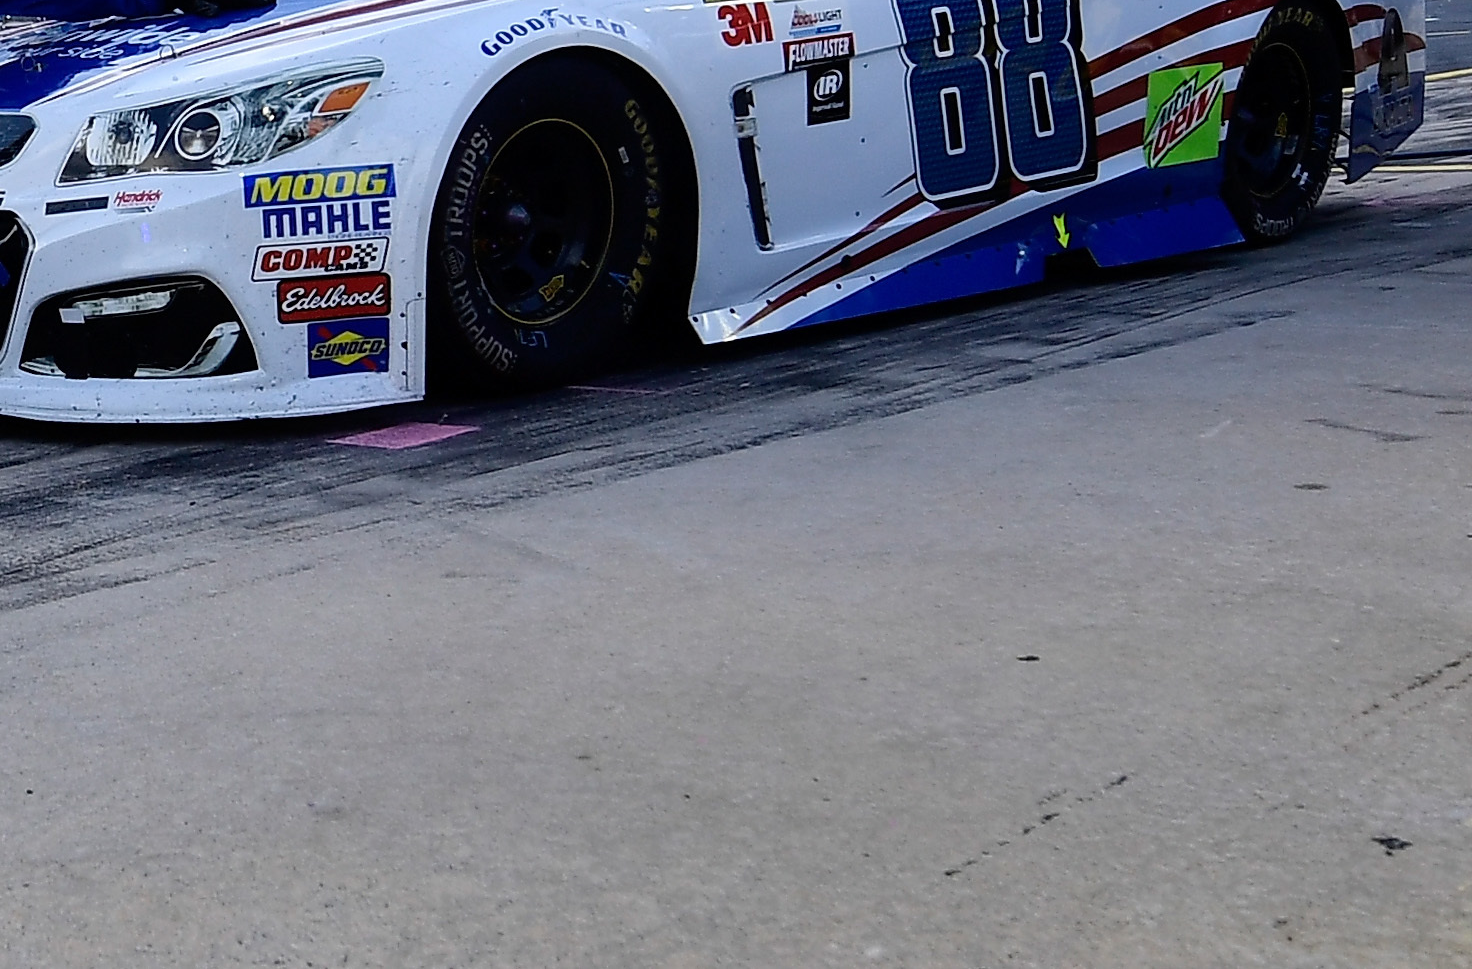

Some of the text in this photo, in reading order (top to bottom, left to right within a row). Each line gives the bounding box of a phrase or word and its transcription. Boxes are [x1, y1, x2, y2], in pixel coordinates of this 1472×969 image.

[480, 7, 628, 56] GOODYEAR
[718, 2, 775, 46] 3M
[818, 9, 842, 22] LIGHT
[788, 36, 850, 72] FLOWMASTER
[818, 75, 838, 96] IR
[113, 190, 163, 207] Hendrick
[250, 168, 389, 205] MOOG
[624, 98, 660, 294] GOODYEAR
[262, 200, 392, 239] MAHLE
[260, 245, 354, 273] COMP
[324, 261, 370, 273] CAMS
[447, 131, 516, 372] SUPPORT TROOPS
[281, 284, 386, 313] Edelbrock
[312, 339, 384, 359] SUNOCO
